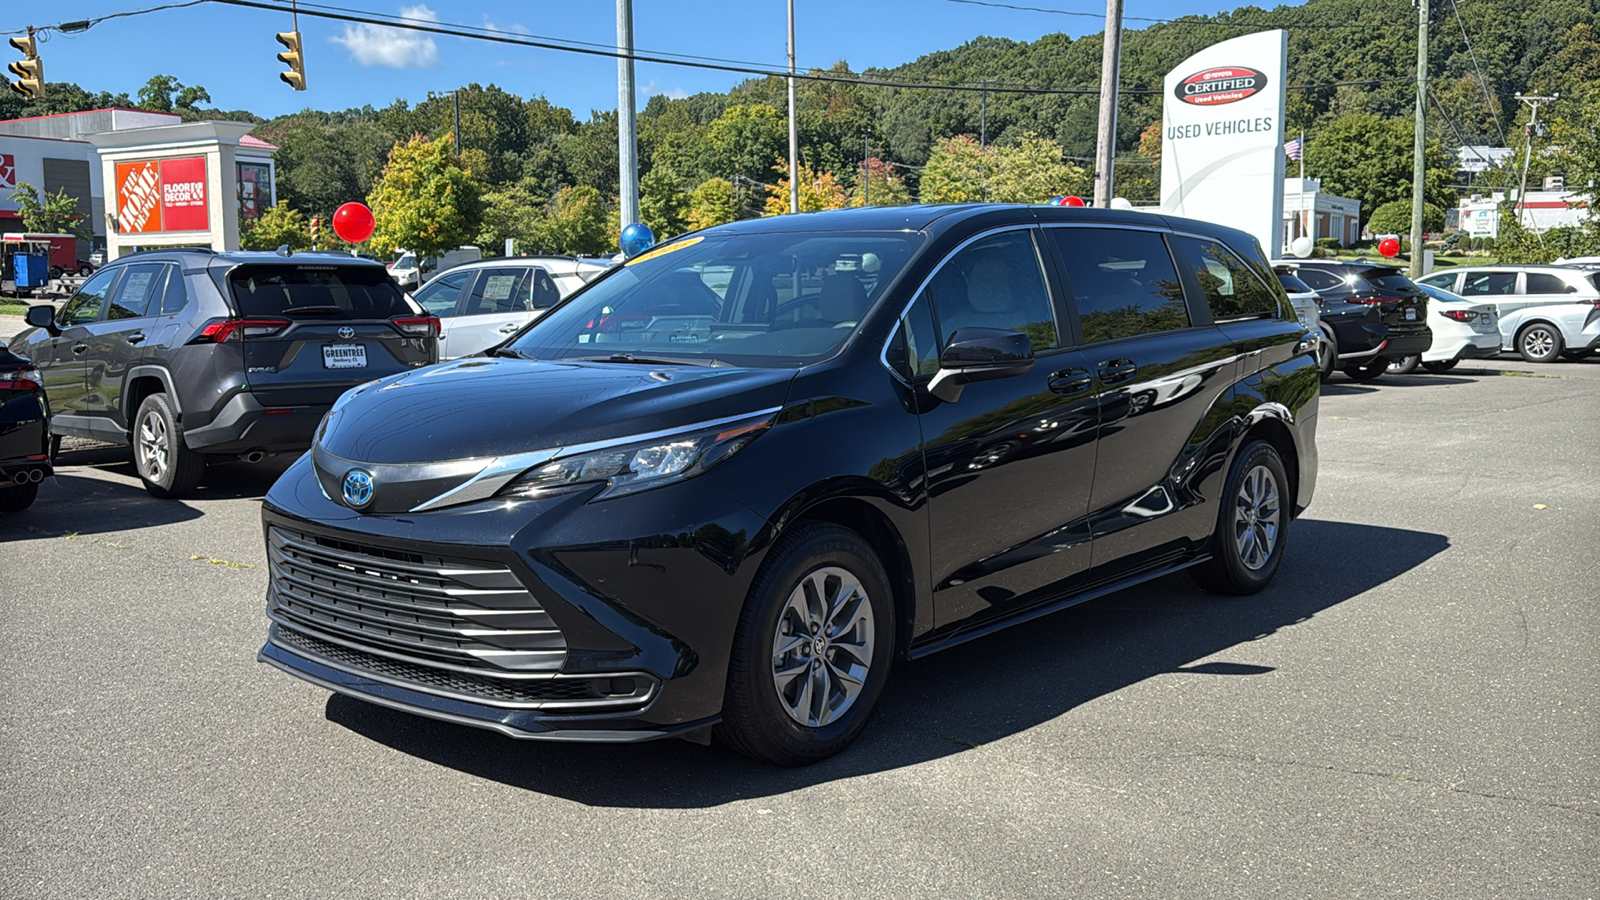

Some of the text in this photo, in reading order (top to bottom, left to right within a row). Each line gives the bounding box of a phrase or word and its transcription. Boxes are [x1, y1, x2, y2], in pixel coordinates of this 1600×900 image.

[1211, 71, 1233, 79] TOYOTA
[1184, 78, 1256, 95] CERTIFIED
[1194, 92, 1243, 103] Used Vehicles
[1167, 117, 1272, 140] USED VEHICLES
[121, 167, 140, 199] THE
[163, 181, 204, 200] FLOOR &
[118, 161, 159, 233] HOME
[164, 192, 191, 202] DECOR
[134, 186, 160, 233] DEPOT
[325, 348, 364, 358] GREENTREE
